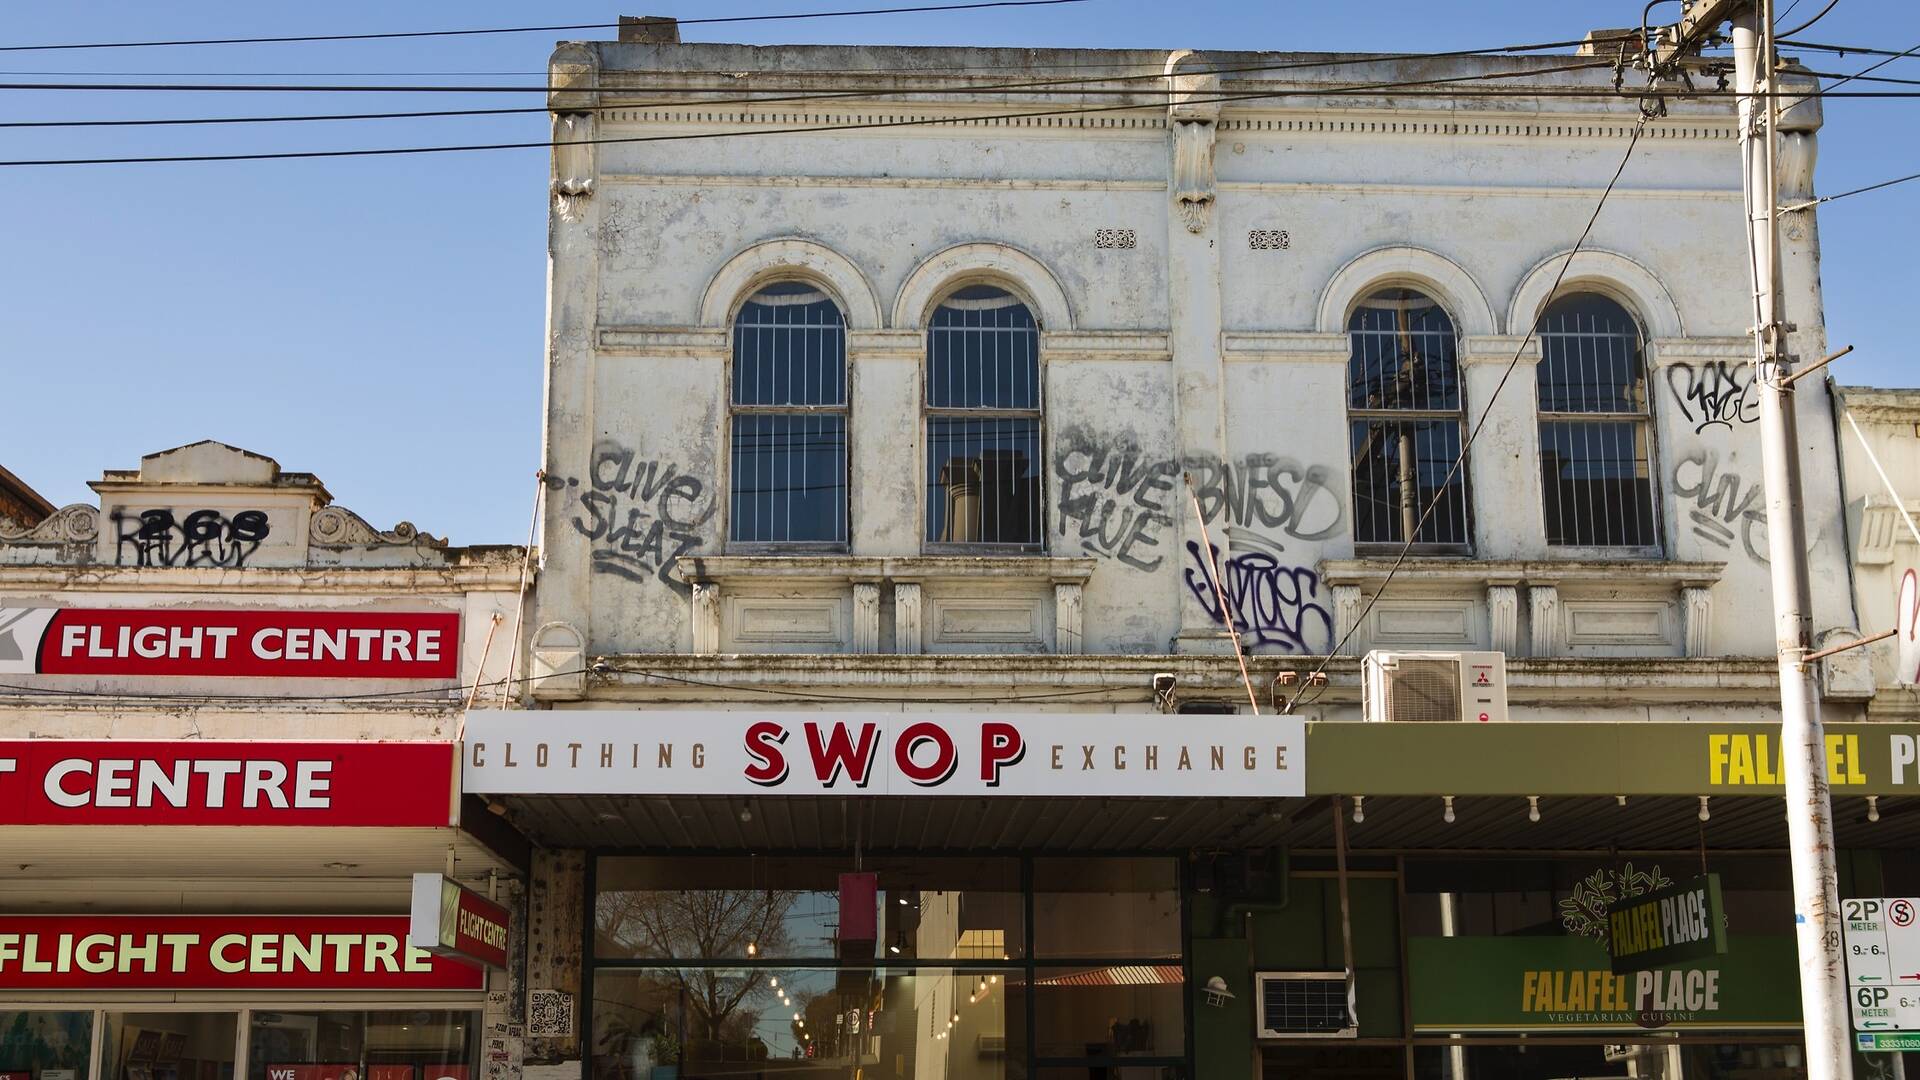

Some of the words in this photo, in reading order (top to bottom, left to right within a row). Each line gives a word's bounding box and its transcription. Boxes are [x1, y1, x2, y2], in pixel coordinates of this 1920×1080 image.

[61, 625, 237, 659] FLIGHT
[251, 627, 441, 662] CENTRE
[472, 742, 706, 769] CLOTHING
[743, 720, 1027, 788] SWOP
[1050, 744, 1289, 771] EXCHANGE
[1708, 734, 1867, 785] FALEL
[1890, 734, 1920, 785] P
[43, 758, 333, 809] CENTRE
[460, 908, 486, 941] FLIGHT
[483, 920, 507, 951] CENTRE
[1610, 900, 1663, 957] FALAFEL
[1660, 889, 1709, 946] PLACE
[1846, 901, 1879, 921] 2P
[1851, 922, 1878, 931] METER
[0, 934, 199, 973] FLIGHT
[209, 934, 432, 973] CENTRE
[1522, 970, 1629, 1012] FALAFEL
[1635, 969, 1719, 1011] PLACE
[1857, 987, 1889, 1008] 6P
[1549, 1013, 1633, 1022] VEGETARIAN
[1641, 1012, 1695, 1021] CUISINE
[1861, 1008, 1889, 1017] METER
[270, 1069, 295, 1080] WE
